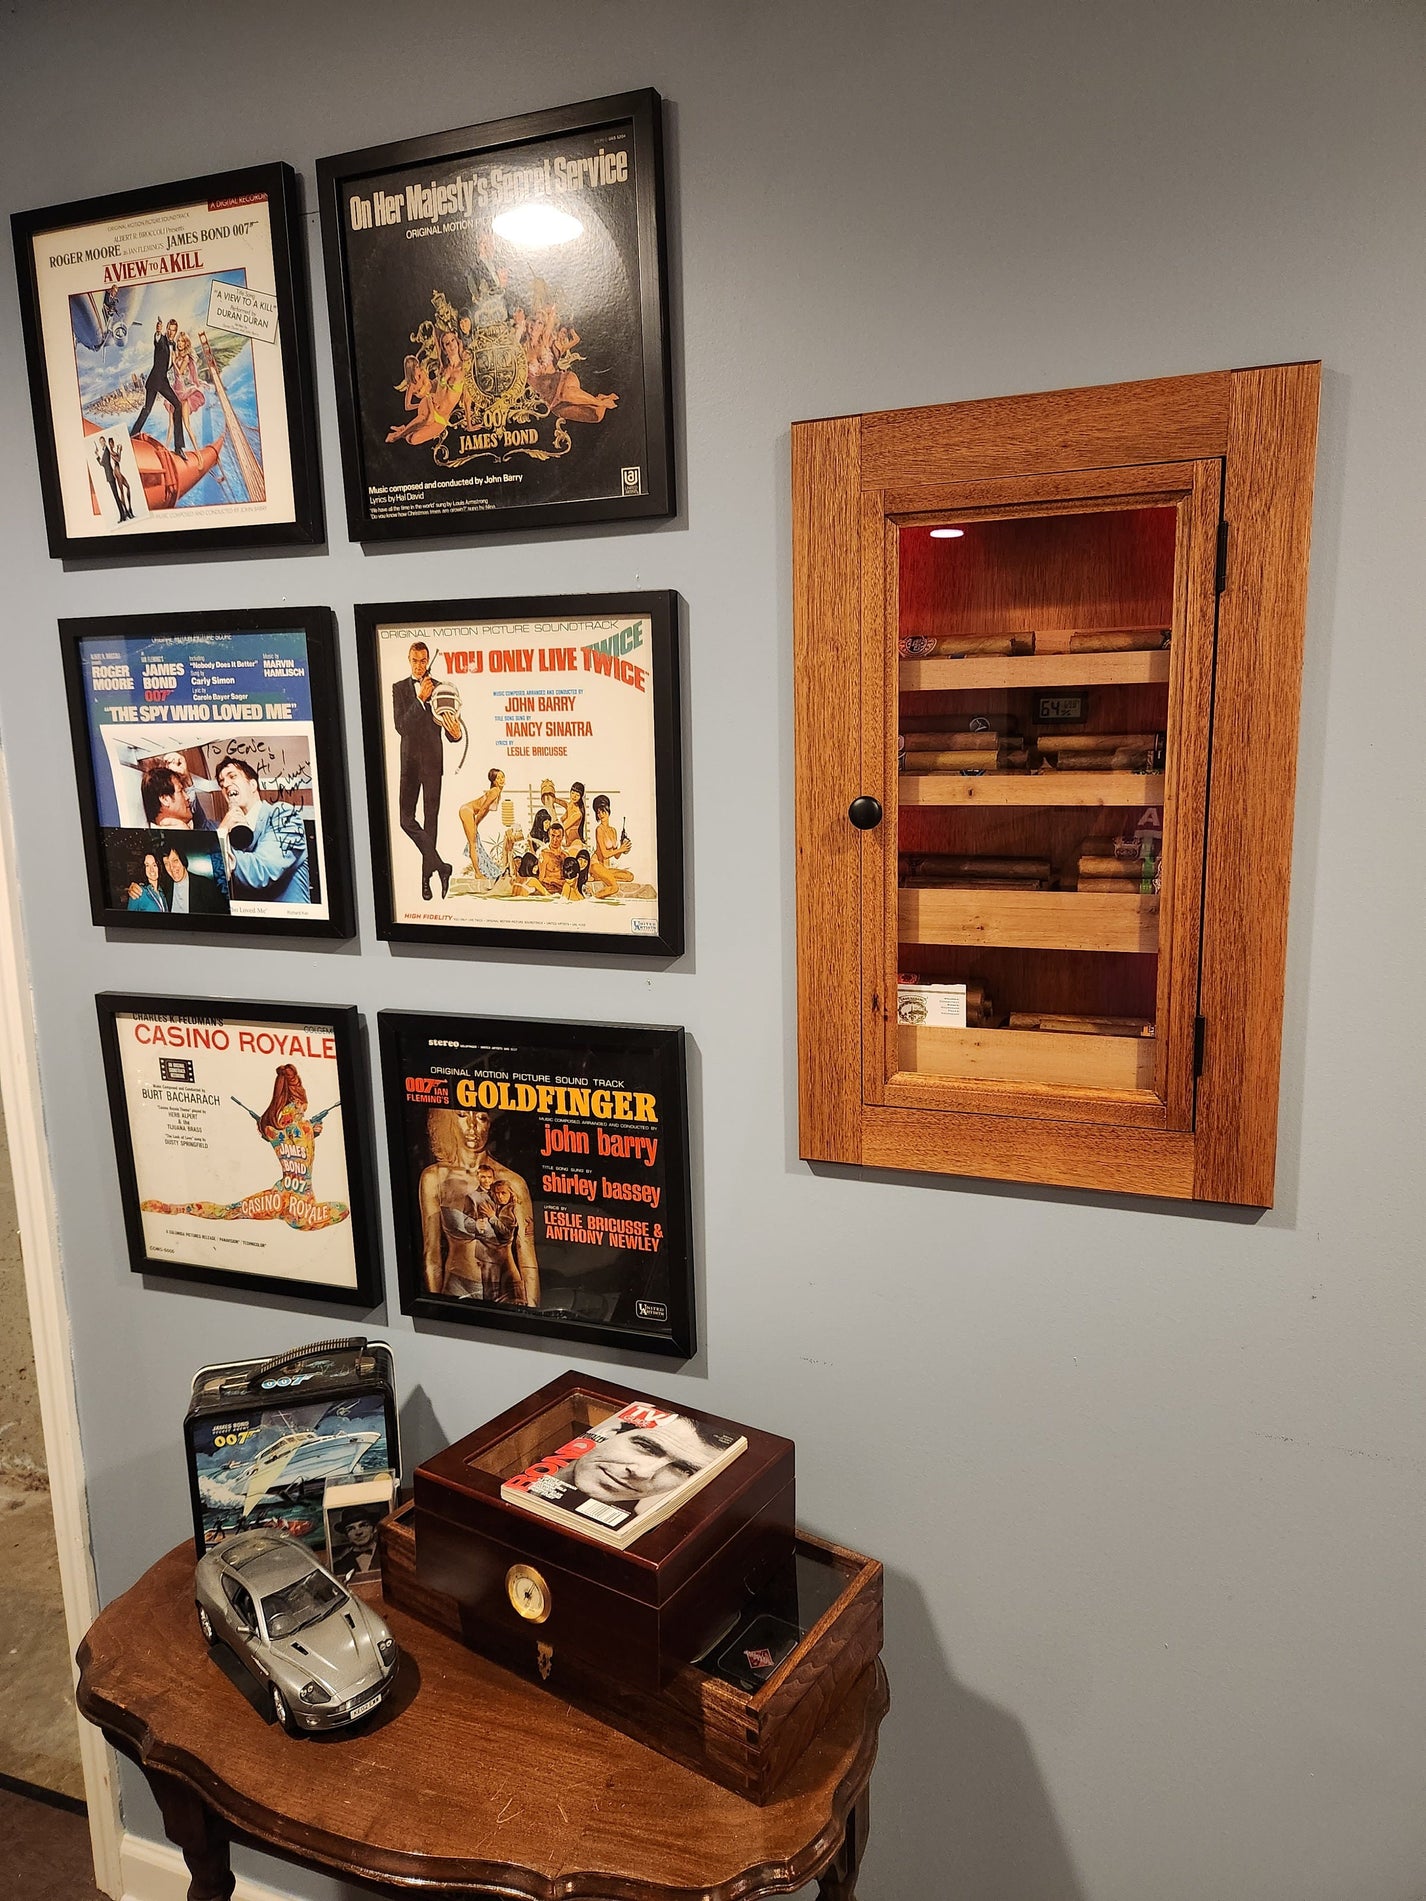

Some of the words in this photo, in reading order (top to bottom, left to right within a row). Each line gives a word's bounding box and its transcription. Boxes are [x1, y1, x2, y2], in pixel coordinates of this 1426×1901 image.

[350, 195, 373, 231] On
[374, 191, 405, 226] Her
[406, 174, 488, 223] Majesty's
[553, 148, 628, 193] Service
[405, 226, 443, 240] ORIGINAL
[443, 220, 474, 234] MOTION
[49, 251, 83, 269] ROGER
[84, 244, 122, 261] MOORE
[166, 231, 199, 251] JAMES
[200, 225, 231, 242] BOND
[232, 221, 252, 236] 007
[103, 267, 112, 283] A
[111, 260, 149, 282] VIEW
[149, 261, 159, 273] TO
[159, 257, 169, 274] A
[169, 252, 204, 272] KILL
[223, 291, 240, 304] VIEW
[242, 296, 252, 307] TO
[252, 300, 258, 309] A
[259, 301, 277, 313] KILL"
[216, 307, 242, 321] DURAN
[243, 315, 269, 329] DURAN
[459, 433, 498, 454] JAMES
[504, 428, 539, 448] BOND
[368, 486, 389, 495] Music
[389, 481, 424, 494] composed
[424, 480, 437, 490] and
[437, 479, 474, 489] conducted
[475, 477, 485, 487] by
[484, 475, 502, 485] John
[503, 473, 524, 483] Barry
[369, 495, 387, 505] Lyrics
[387, 494, 396, 504] by
[396, 493, 406, 502] Hal
[407, 491, 425, 501] David
[381, 628, 431, 640] ORIGINAL
[433, 626, 479, 638] MOTION
[482, 623, 531, 635] PICTURE
[534, 619, 619, 633] SOUNDTRACK
[586, 620, 644, 657] TWICE
[91, 664, 130, 678] ROGER
[142, 663, 185, 677] JAMES
[190, 661, 215, 670] "Nobody
[215, 660, 231, 669] Does
[236, 660, 259, 668] Better"
[263, 660, 295, 669] MARVIN
[264, 668, 305, 678] HAMLISCH
[488, 648, 534, 674] ONLY
[538, 647, 578, 672] LIVE
[580, 646, 650, 693] TWICE"
[93, 677, 135, 691] MOORE
[143, 676, 178, 690] BOND
[191, 677, 211, 686] Carly
[211, 676, 236, 685] Simon
[144, 689, 170, 703] 007
[193, 693, 213, 701] Carole
[212, 693, 231, 702] Bayer
[230, 692, 249, 702] Sager
[505, 697, 535, 713] JOHN
[538, 696, 576, 712] BARRY
[104, 705, 138, 723] "THE
[139, 704, 170, 722] SPY
[169, 704, 211, 722] WHO
[211, 704, 263, 722] LOVED
[265, 702, 297, 720] ME"
[505, 721, 543, 737] NANCY
[545, 721, 593, 737] SINATRA
[507, 746, 531, 757] LESLIE
[532, 746, 568, 757] BRICUSSE
[423, 913, 453, 921] FIDELITY
[132, 1012, 167, 1023] CHARLES
[179, 1015, 224, 1027] FELDMAN'S
[135, 1023, 230, 1051] CASINO
[239, 1031, 337, 1060] ROYALE
[428, 1038, 460, 1048] stereo
[430, 1065, 471, 1078] ORIGINAL
[474, 1069, 509, 1080] MOTION
[512, 1072, 551, 1084] PICTURE
[555, 1075, 589, 1087] SOUND
[593, 1078, 625, 1089] TRACK
[405, 1076, 440, 1094] 007
[434, 1087, 449, 1097] IAN
[142, 1089, 163, 1100] BURT
[166, 1091, 221, 1106] BACHARACH
[406, 1093, 450, 1105] FLEMING'S
[456, 1078, 659, 1124] GOLDFINGER
[620, 1123, 650, 1131] CONDUCTED
[279, 1143, 307, 1159] JAMES
[540, 1123, 590, 1157] john
[597, 1127, 658, 1167] barry
[282, 1160, 307, 1176] BOND
[284, 1176, 307, 1193] 007
[542, 1171, 598, 1202] shirley
[601, 1176, 661, 1209] bassey
[241, 1192, 282, 1215] CASINO
[288, 1197, 329, 1225] ROYALE
[544, 1210, 583, 1229] LESLIE
[587, 1215, 650, 1237] BRICUSSE
[653, 1223, 664, 1239] &
[545, 1226, 604, 1246] ANTHONY
[608, 1232, 660, 1253] NEWLEY
[261, 1374, 314, 1390] 007
[629, 1405, 679, 1427] TV
[211, 1422, 233, 1432] JAMES
[232, 1420, 250, 1429] BOND
[214, 1430, 255, 1448] 007
[502, 1438, 597, 1492] BOND
